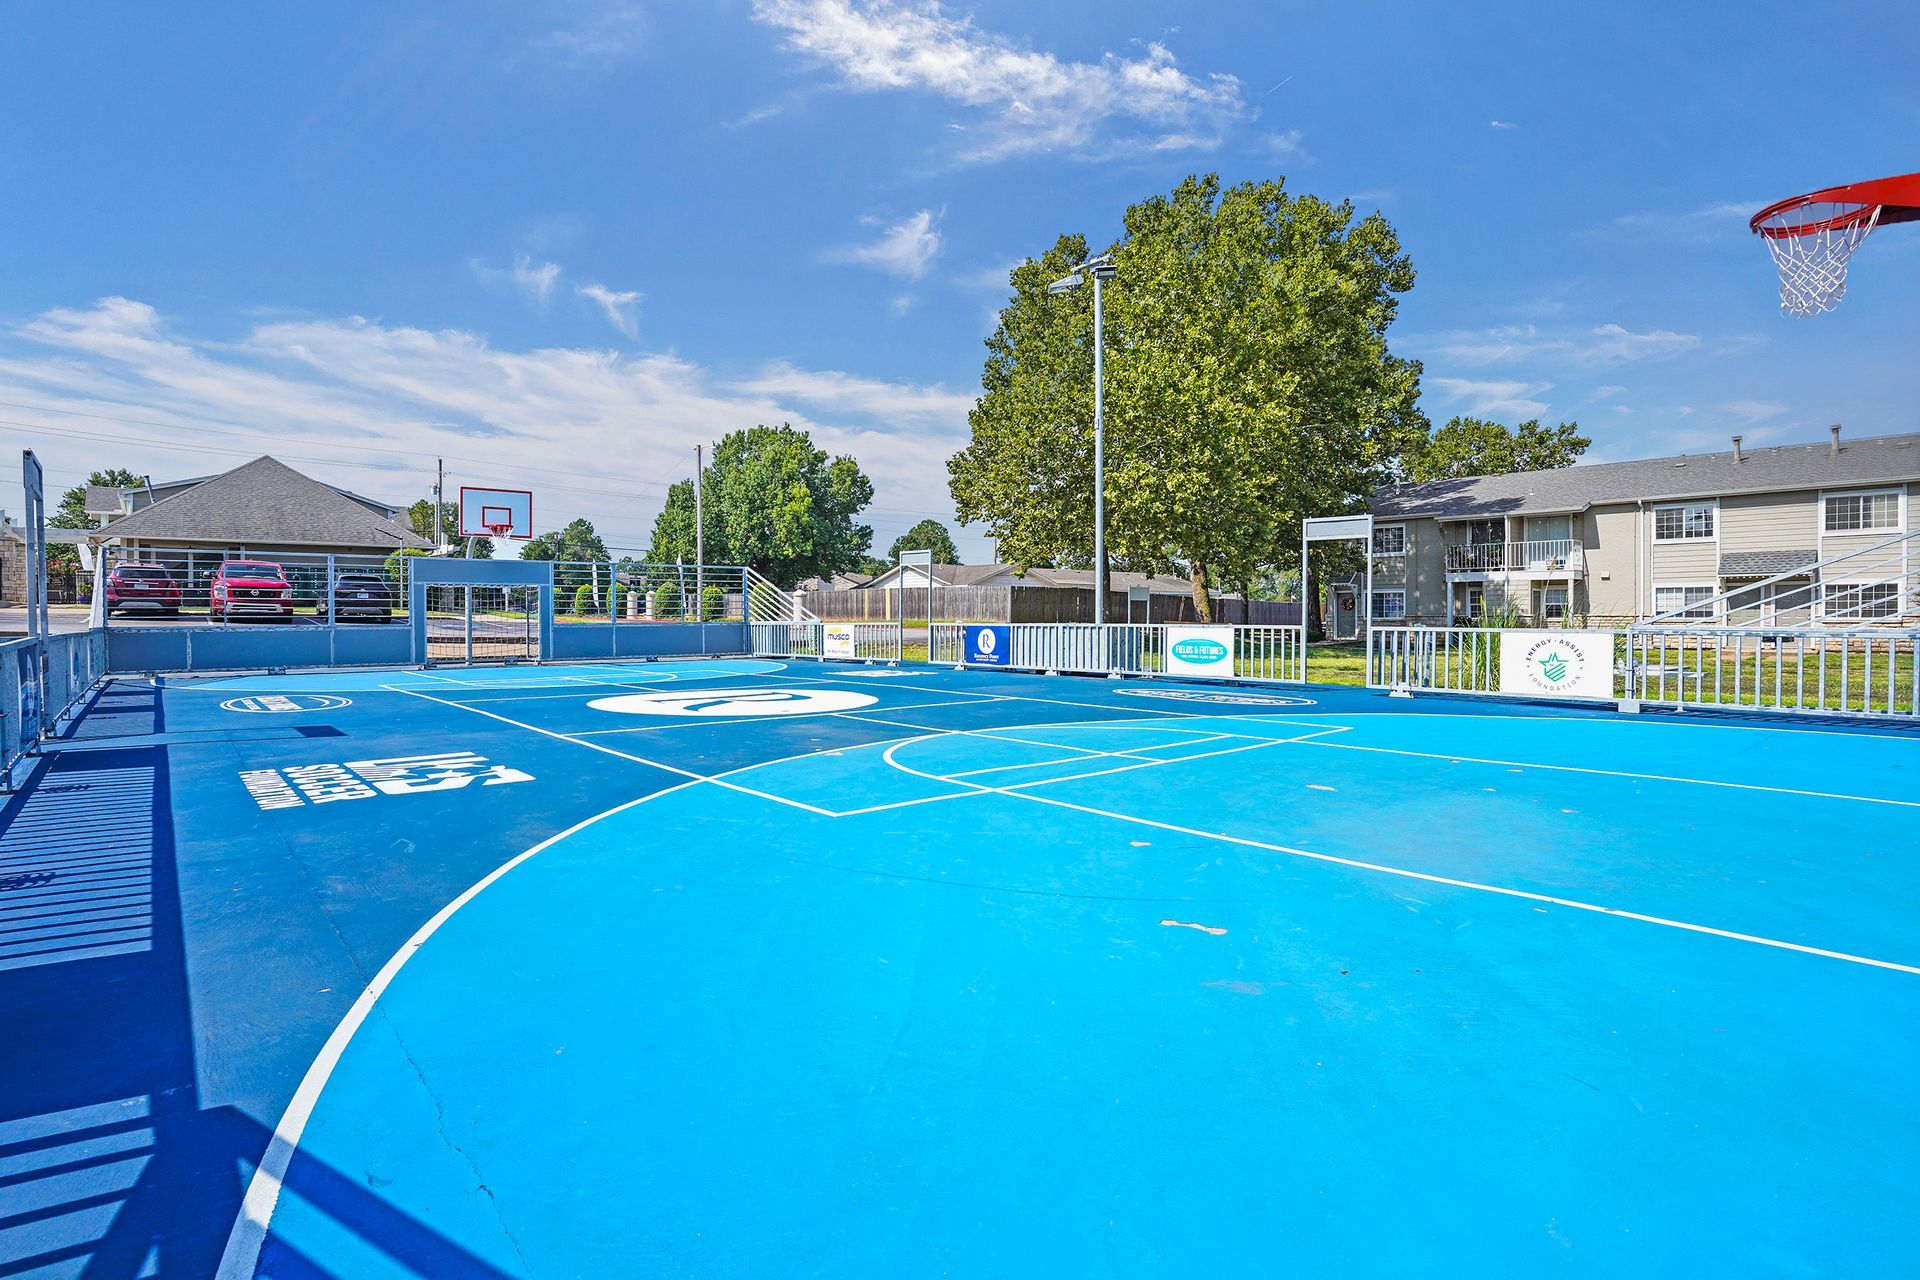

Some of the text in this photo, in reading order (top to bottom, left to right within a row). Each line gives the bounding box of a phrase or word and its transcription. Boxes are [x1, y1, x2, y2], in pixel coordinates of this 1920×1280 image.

[827, 633, 850, 641] musco
[982, 634, 990, 648] R
[1175, 645, 1193, 654] FIELDS
[1200, 646, 1224, 655] FUTURES
[1526, 638, 1585, 662] ENERGY ASSIST
[1529, 673, 1581, 691] FOUNDATION
[238, 768, 306, 811] FOUNDATION
[282, 763, 378, 805] SOCCER
